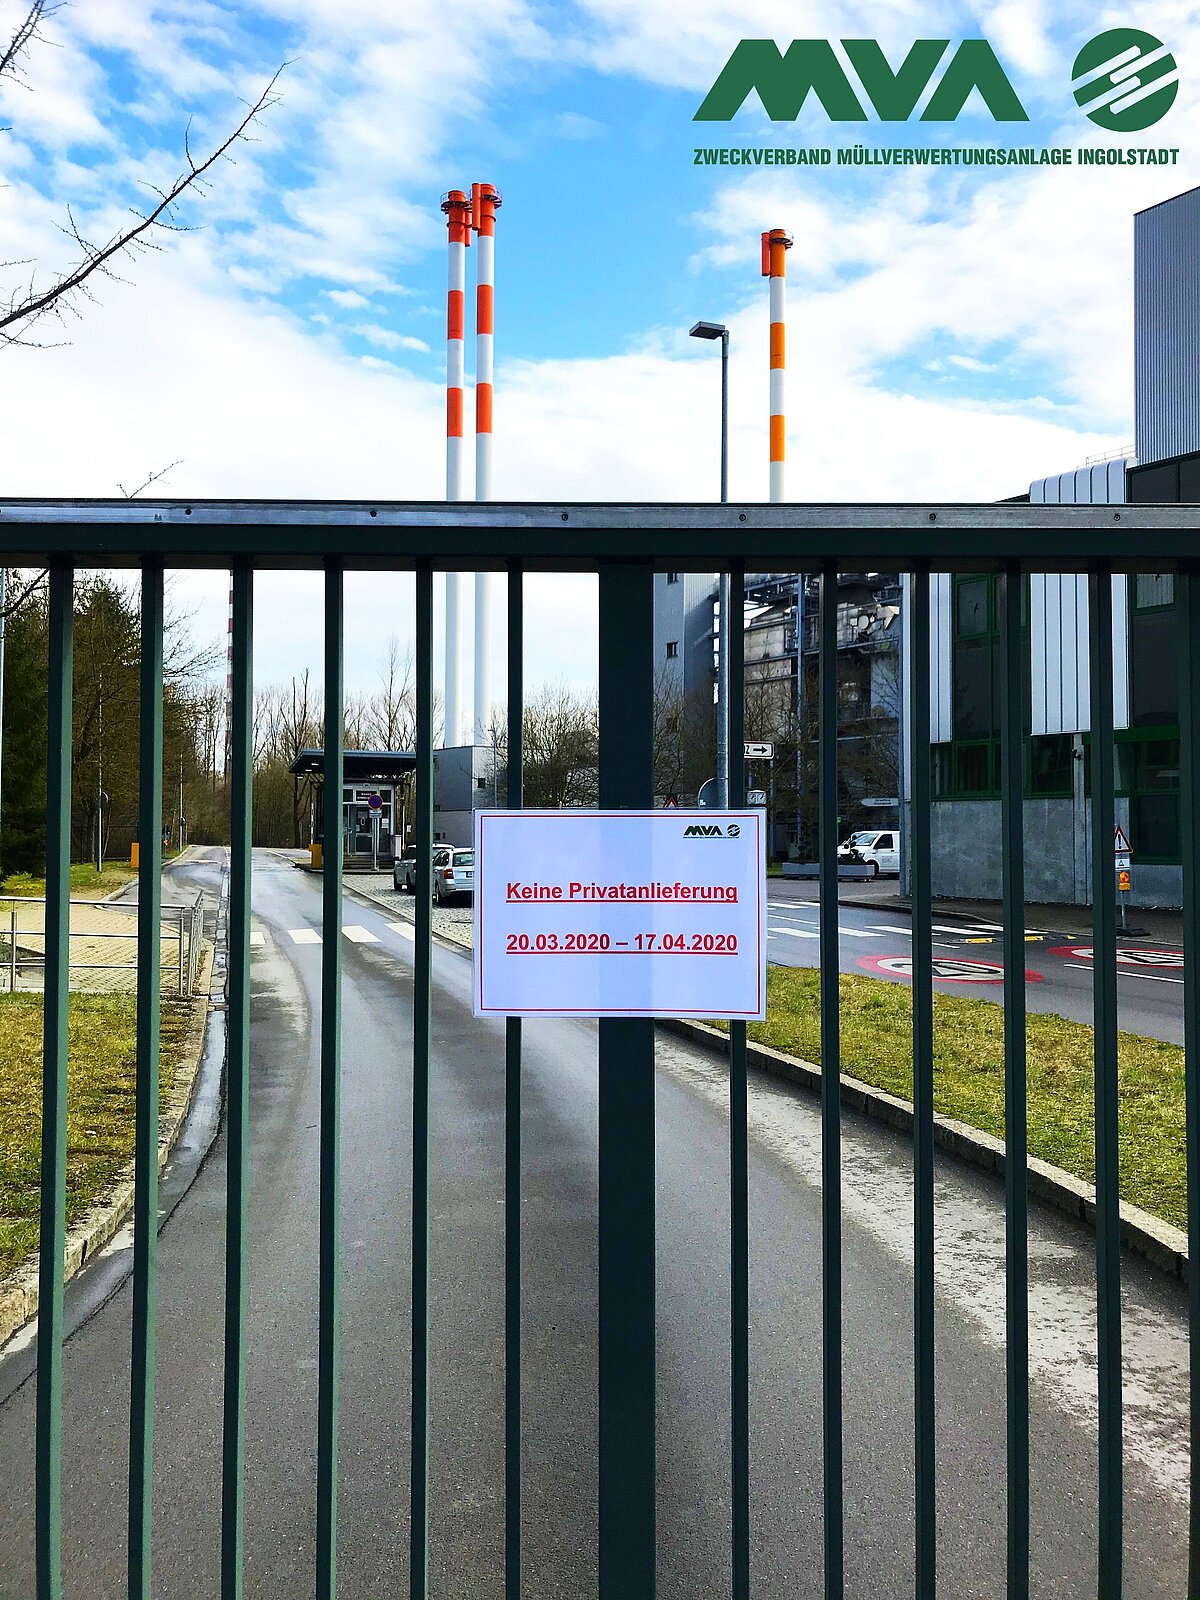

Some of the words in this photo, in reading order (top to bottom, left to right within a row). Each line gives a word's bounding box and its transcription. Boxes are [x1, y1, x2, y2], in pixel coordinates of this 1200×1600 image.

[683, 825, 723, 836] MVA
[506, 882, 563, 899] Keine
[569, 882, 738, 902] Privatanlieferung
[506, 933, 611, 951] 20.03.2020
[634, 934, 738, 952] 17.04.2020
